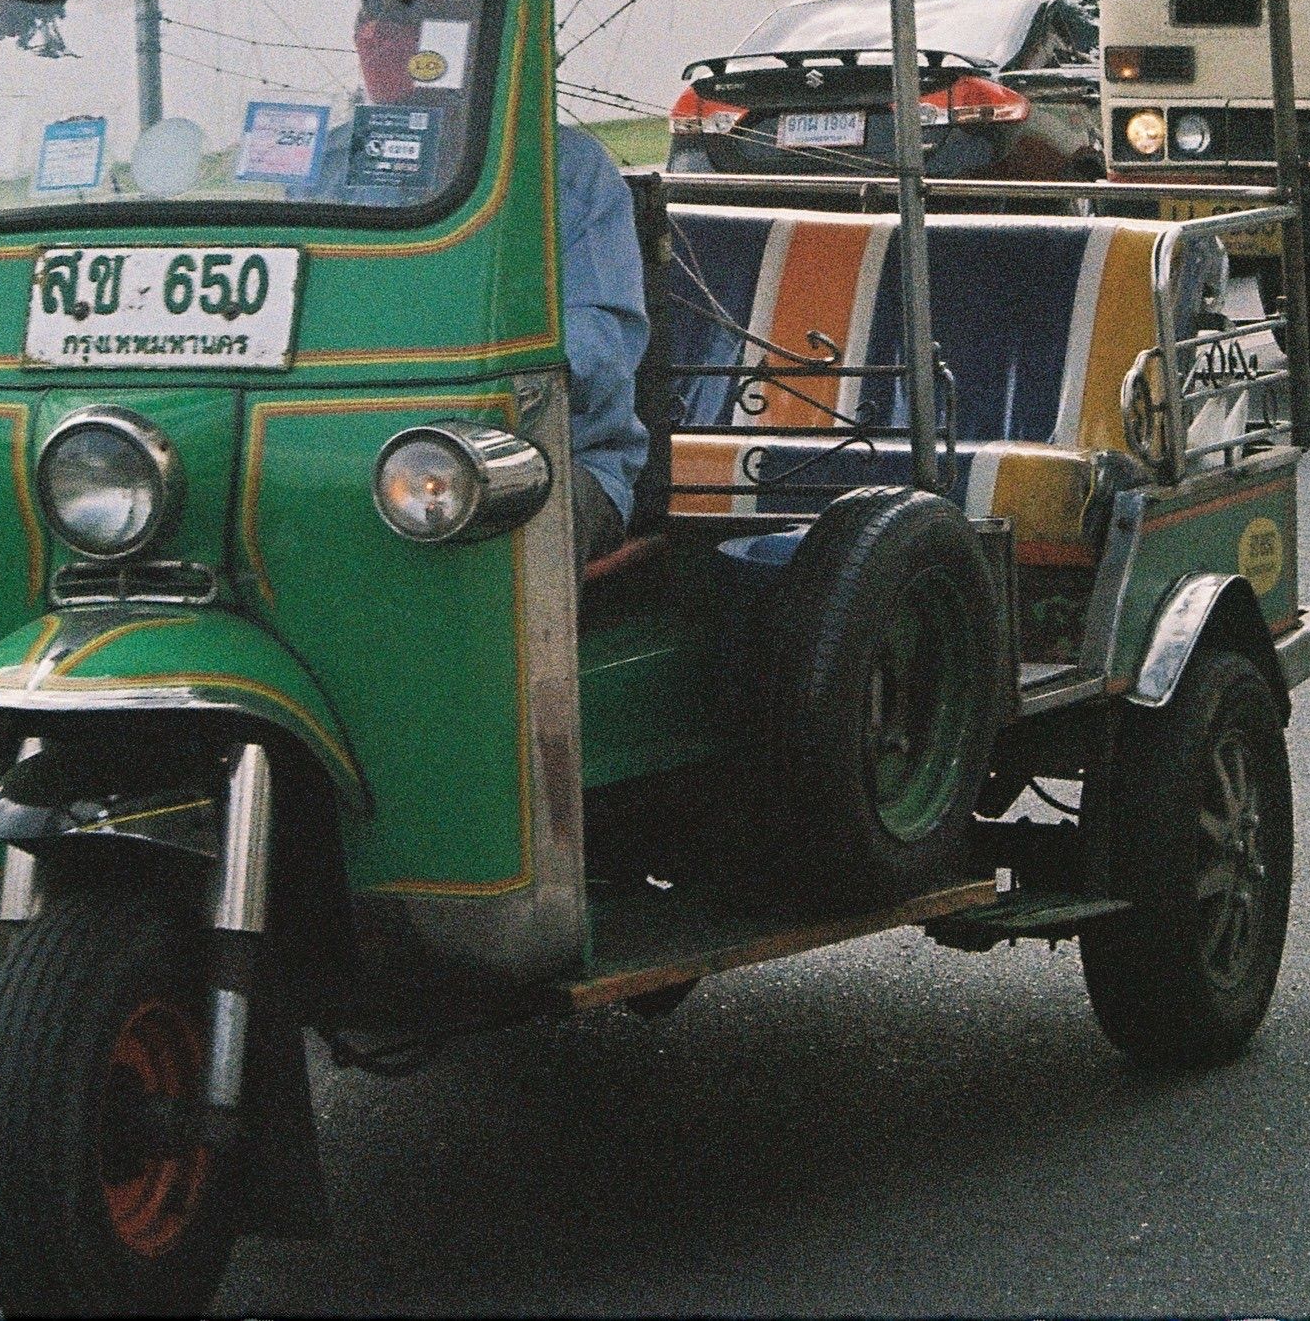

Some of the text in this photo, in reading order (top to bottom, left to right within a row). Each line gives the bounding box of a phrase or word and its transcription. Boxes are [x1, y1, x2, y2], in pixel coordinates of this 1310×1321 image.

[41, 250, 269, 316] สข 650
[62, 333, 250, 364] กรุงเทพมหานคร
